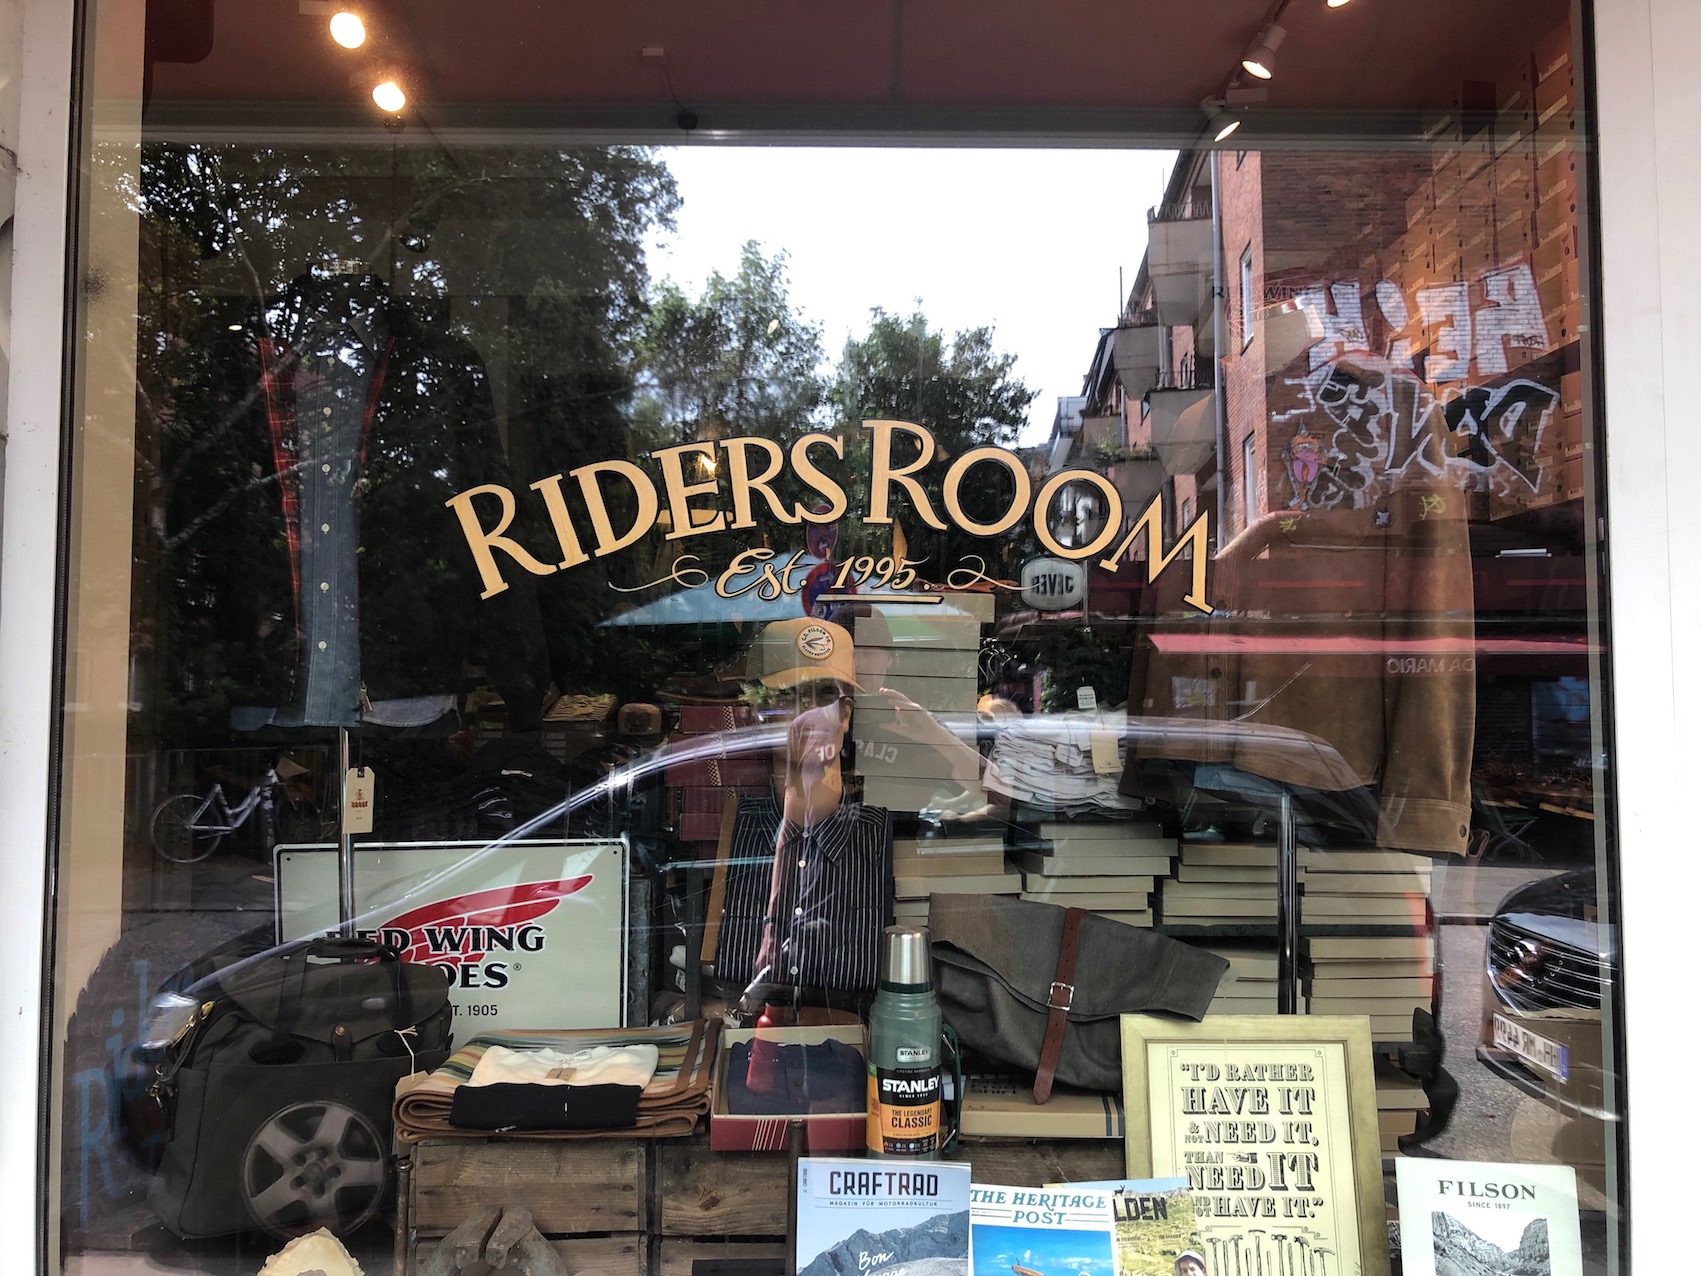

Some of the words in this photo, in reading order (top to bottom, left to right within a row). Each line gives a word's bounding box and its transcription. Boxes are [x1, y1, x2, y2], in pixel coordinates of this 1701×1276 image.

[715, 548, 808, 600] Est.
[424, 926, 545, 952] WING
[467, 1005, 498, 1016] 1905
[1224, 1063, 1315, 1082] RATHER
[883, 1075, 940, 1093] STANLEY
[1181, 1086, 1269, 1115] HAVE
[1277, 1086, 1316, 1115] IT
[891, 1115, 932, 1128] CLASSIC
[904, 1107, 932, 1117] LEGENDARY
[1184, 1134, 1204, 1144] NOT
[1204, 1121, 1277, 1144] NEED
[1282, 1121, 1320, 1147] IT,
[1188, 1121, 1199, 1134] &
[1184, 1151, 1224, 1164] THAN
[1185, 1165, 1266, 1191] NEED
[1266, 1152, 1320, 1191] IT
[829, 1171, 939, 1197] CRAFTRAD
[1438, 1179, 1537, 1200] FILSON
[970, 1189, 1007, 1204] THE
[1011, 1191, 1107, 1211] HERITAGE
[1113, 1197, 1168, 1222] LDEN
[1193, 1195, 1211, 1207] ND
[1193, 1206, 1211, 1217] OT
[1211, 1195, 1277, 1218] HAVE
[1467, 1201, 1490, 1209] SINCE
[1012, 1210, 1067, 1225] POST
[859, 1250, 894, 1270] Bon
